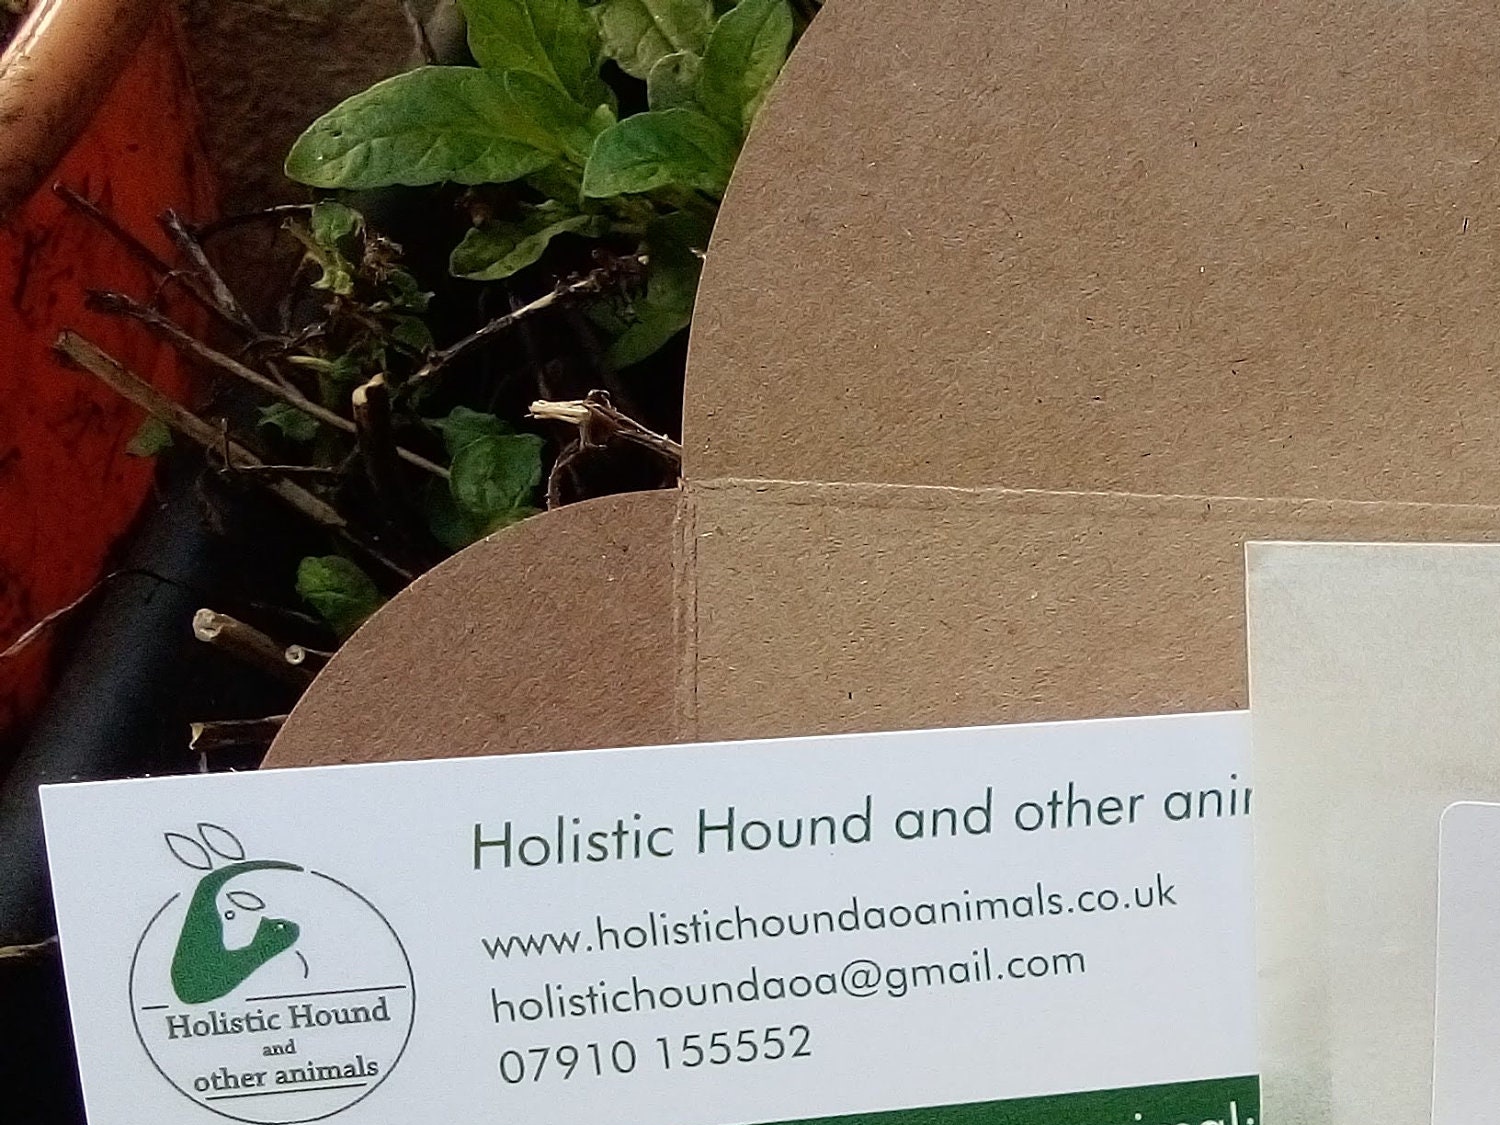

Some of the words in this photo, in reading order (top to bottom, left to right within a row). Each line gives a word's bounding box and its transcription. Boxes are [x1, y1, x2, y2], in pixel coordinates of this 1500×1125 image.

[472, 813, 674, 870] Holistic
[697, 795, 872, 854] Hound
[894, 787, 992, 840] and
[1015, 781, 1144, 832] other
[482, 873, 1176, 959] www.holistichoundaoanimals.co.uk
[492, 948, 1085, 1023] holistichoundaoa@gmail.com
[165, 1007, 282, 1041] Holistic
[290, 997, 391, 1030] Hound
[262, 1039, 297, 1057] and
[194, 1065, 266, 1094] other
[274, 1056, 379, 1085] animals
[499, 1041, 637, 1085] 07910
[655, 1024, 812, 1069] 155552
